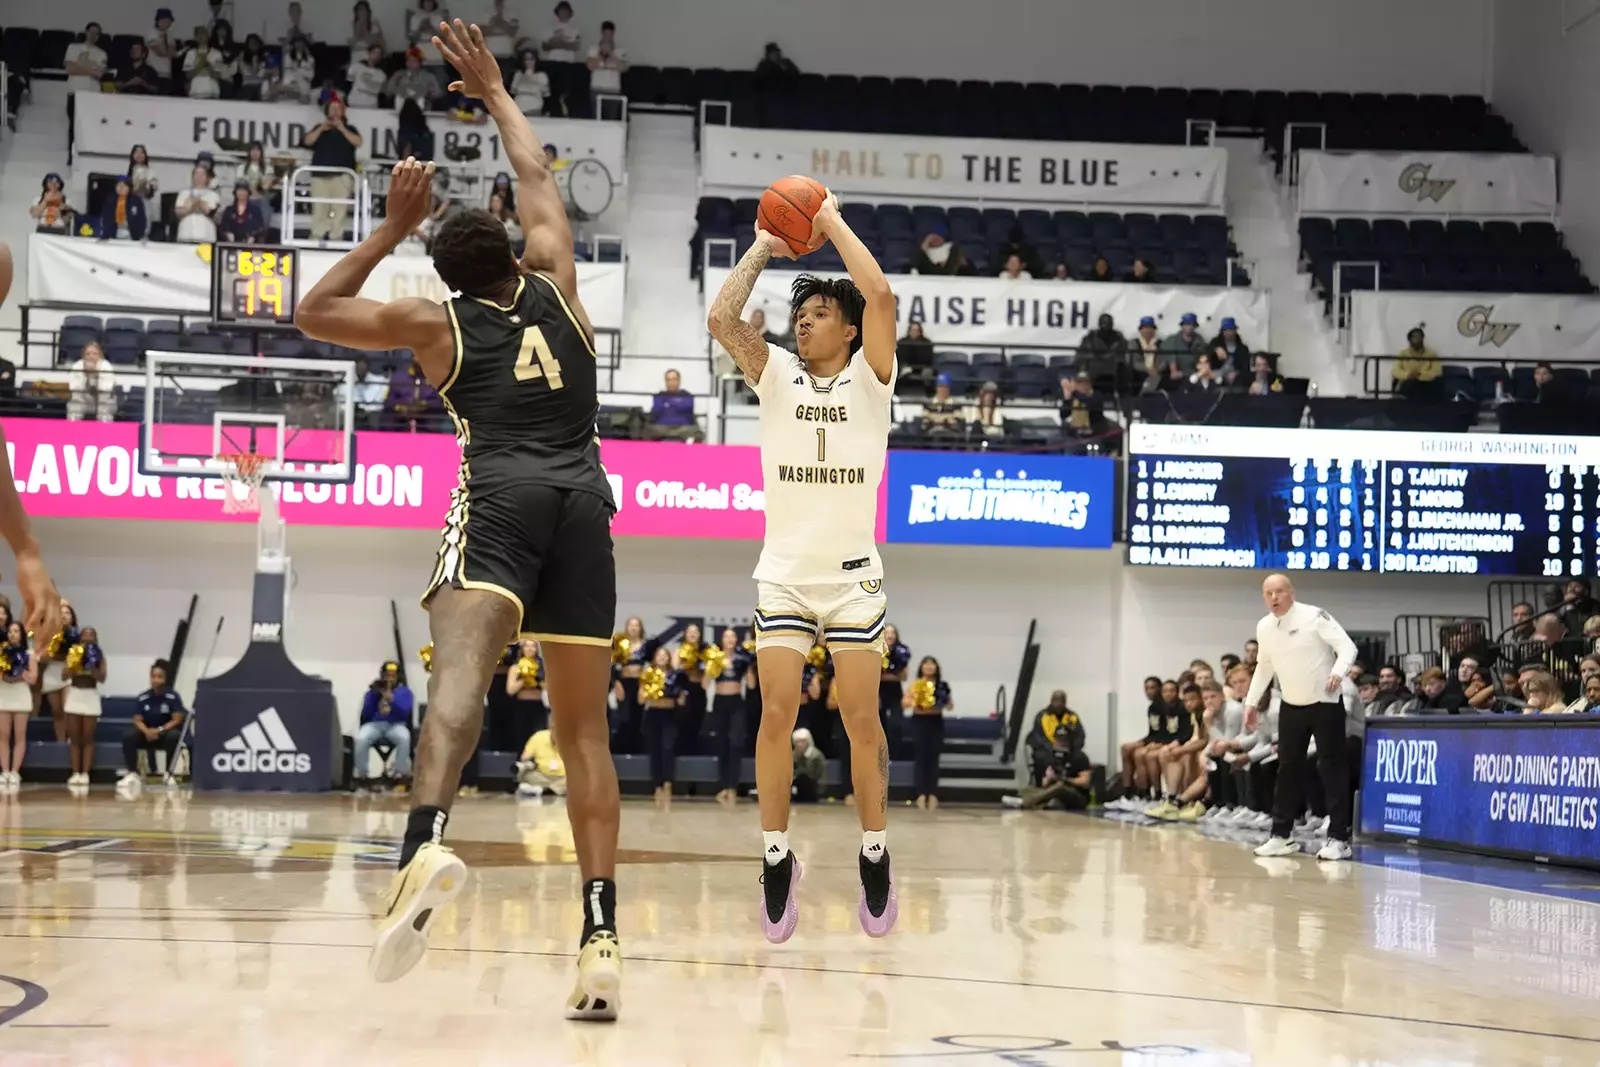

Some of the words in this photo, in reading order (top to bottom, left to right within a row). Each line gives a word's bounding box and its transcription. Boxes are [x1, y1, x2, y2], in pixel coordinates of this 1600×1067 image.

[193, 116, 306, 149] FOUND
[430, 130, 499, 161] 821
[811, 147, 886, 179] HAIL
[903, 152, 944, 181] TO
[962, 154, 1022, 184] THE
[1040, 157, 1119, 187] BLUE
[237, 251, 290, 276] 6:21
[246, 278, 283, 316] 19
[1007, 298, 1090, 329] HIGH
[1457, 304, 1521, 348] GW
[513, 325, 564, 391] 4
[795, 404, 848, 423] GEORGE
[816, 427, 826, 462] 1
[1421, 439, 1473, 453] GEORGE
[1481, 441, 1578, 456] WASHINGTON
[176, 457, 423, 507] REVLUTION
[778, 465, 865, 485] WASHINGTON
[635, 479, 730, 510] Official
[1392, 489, 1402, 507] 1
[1573, 494, 1583, 511] 1
[1363, 531, 1373, 549] 1
[1573, 536, 1582, 554] 1
[1362, 553, 1371, 571] 1
[1543, 558, 1562, 576] 10
[211, 749, 312, 774] adidas
[1374, 738, 1438, 786] PROPER
[1473, 753, 1513, 784] PROUD
[1514, 754, 1558, 787] DINING
[1490, 790, 1505, 821] OF
[1507, 792, 1531, 823] GW
[1530, 793, 1598, 831] ATHLETICS
